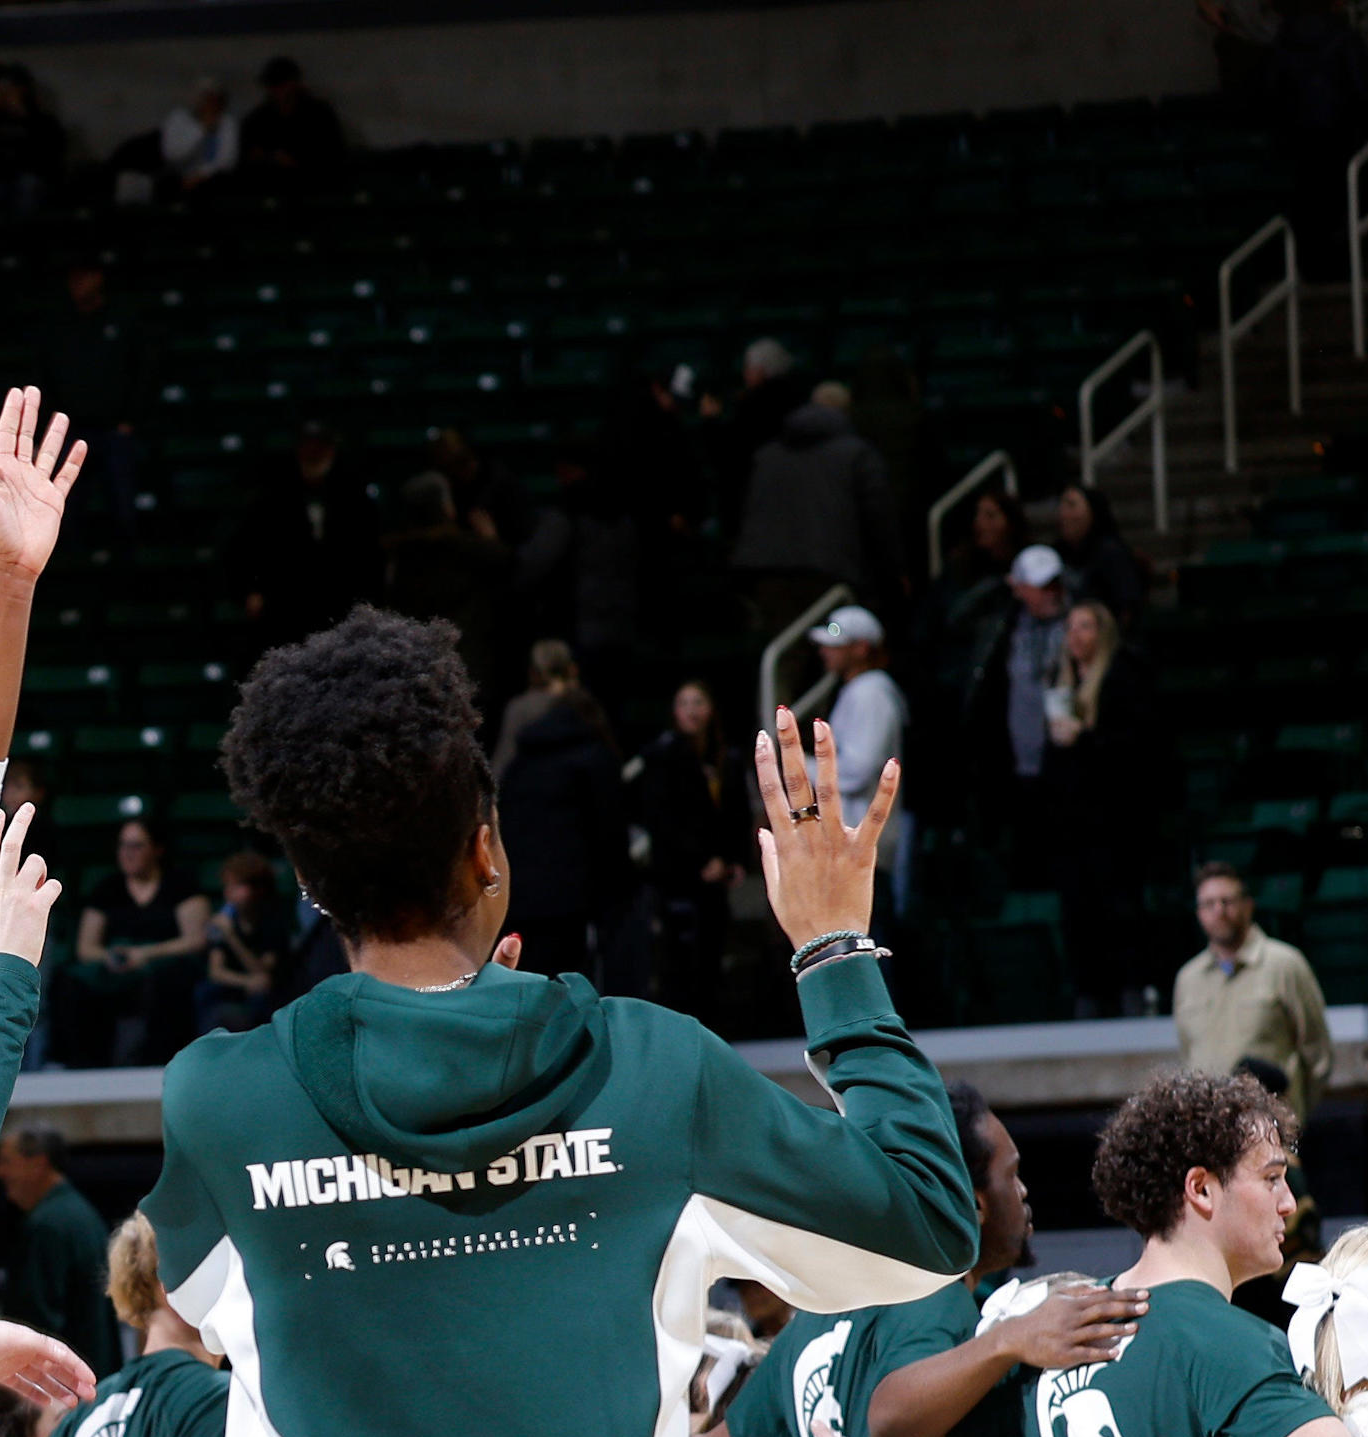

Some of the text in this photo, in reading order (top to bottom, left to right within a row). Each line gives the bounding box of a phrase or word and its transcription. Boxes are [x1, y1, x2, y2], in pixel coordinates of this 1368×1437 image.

[372, 1222, 577, 1255] ENGINEERED FOR
[465, 1232, 578, 1254] BASKETBALL
